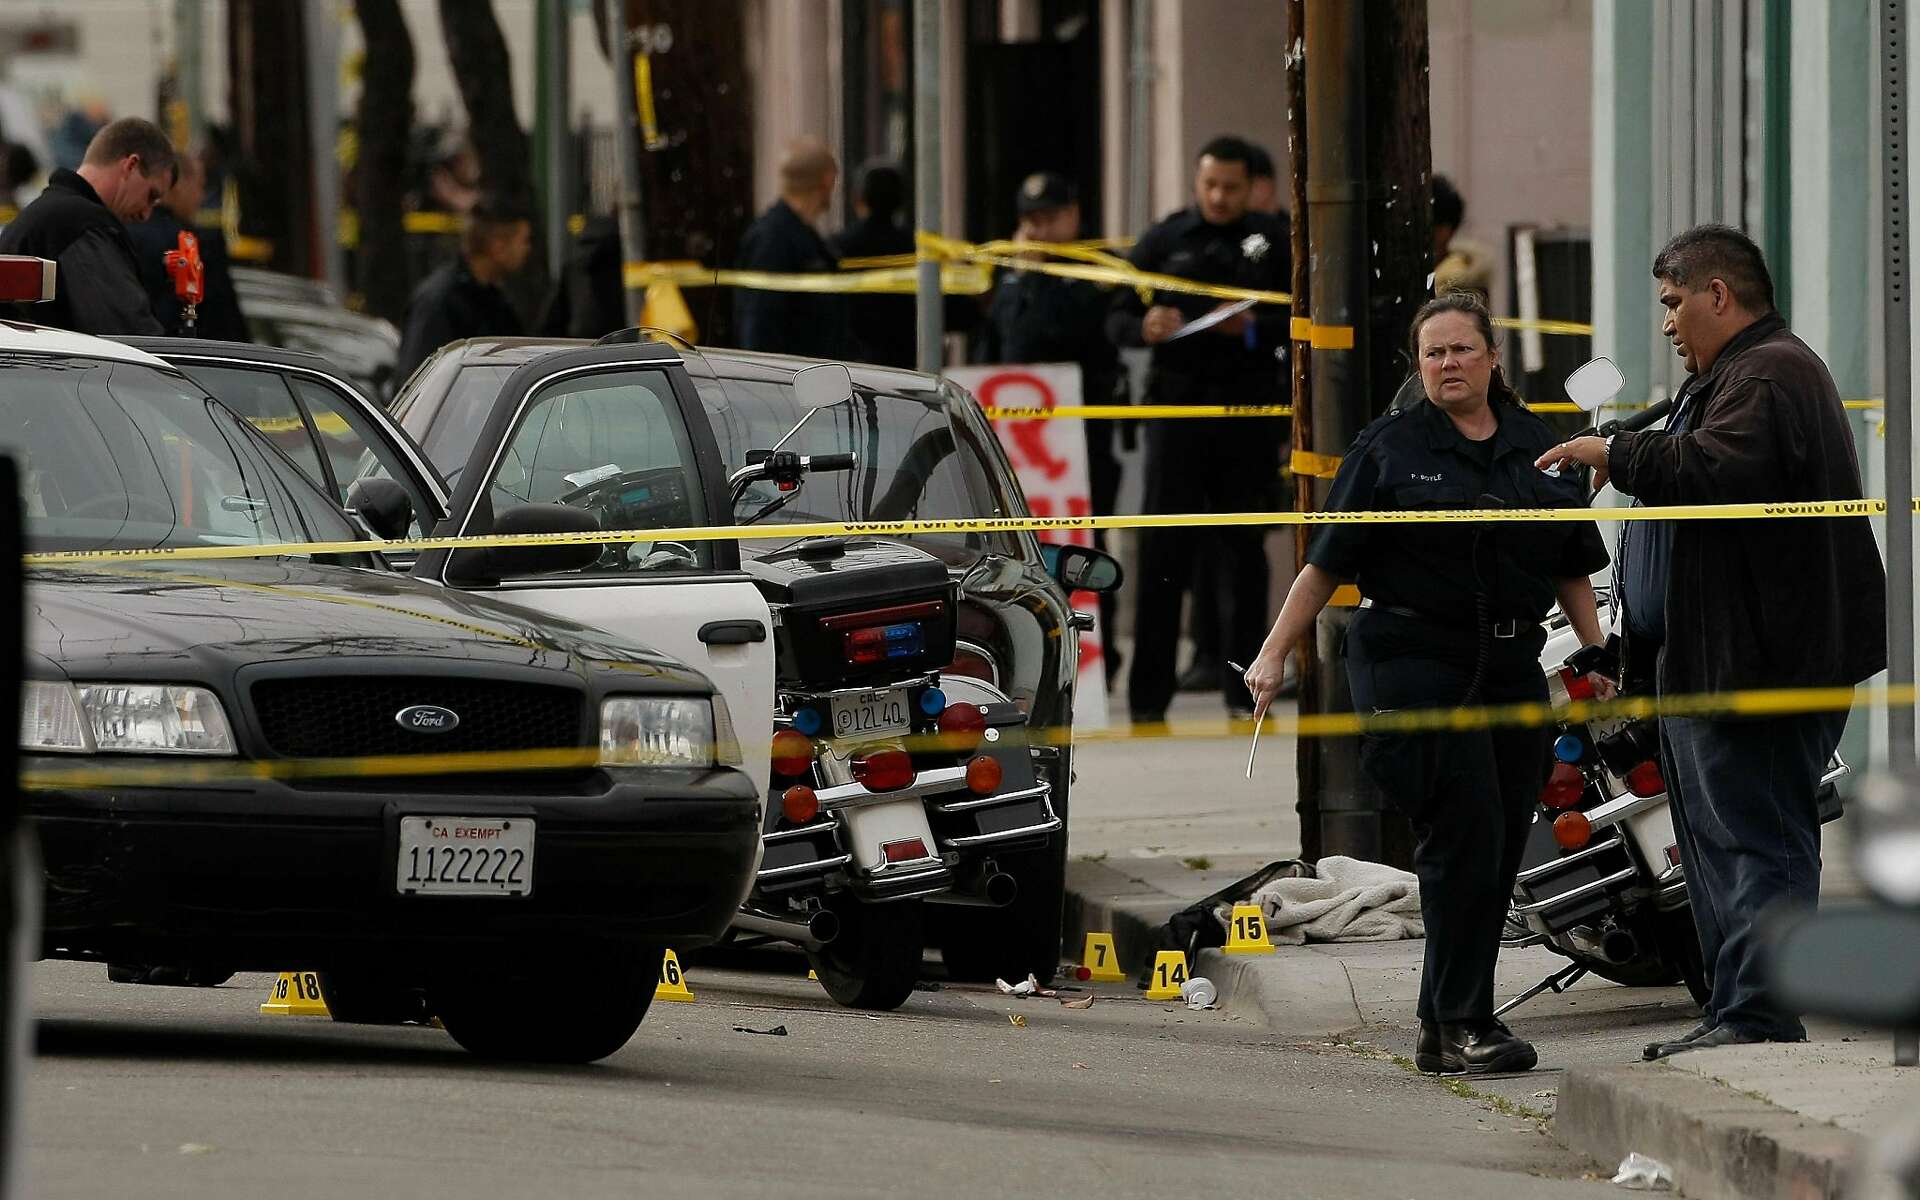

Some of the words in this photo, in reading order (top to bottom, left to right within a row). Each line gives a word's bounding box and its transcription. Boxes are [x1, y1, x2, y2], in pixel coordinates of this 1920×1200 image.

[860, 694, 880, 705] CAL
[412, 710, 444, 726] Ford
[432, 827, 449, 839] CA
[455, 827, 503, 840] EXEMPT
[407, 846, 525, 885] 1122222
[1234, 916, 1261, 940] 15
[1093, 944, 1107, 968] 7
[292, 972, 321, 1000] 18
[1156, 962, 1185, 988] 14
[275, 978, 289, 999] 18
